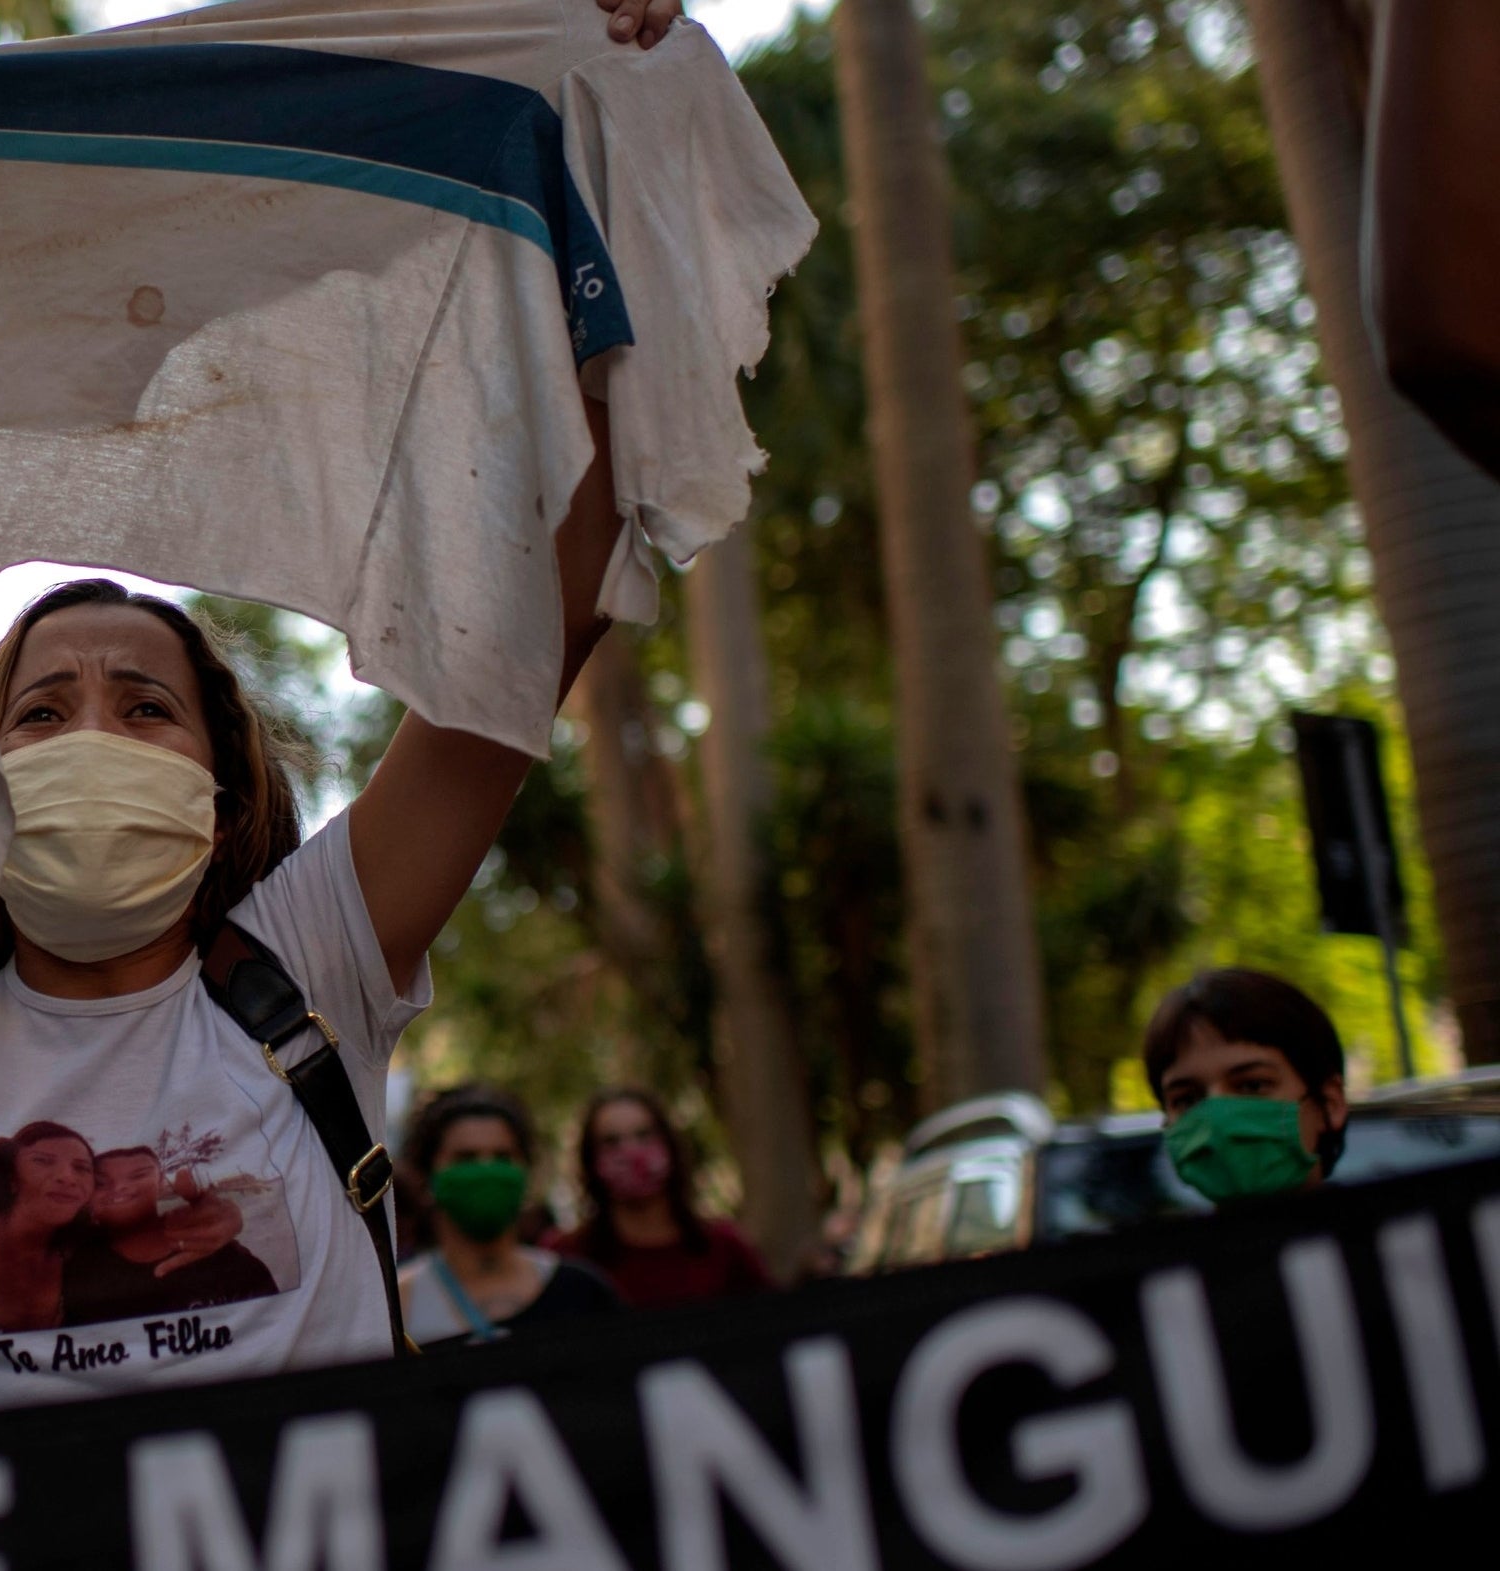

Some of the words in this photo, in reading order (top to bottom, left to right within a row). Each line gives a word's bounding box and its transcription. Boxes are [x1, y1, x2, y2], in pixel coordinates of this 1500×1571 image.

[52, 1334, 129, 1371] Amo
[143, 1315, 233, 1359] Filho
[126, 1181, 1500, 1571] MANGUI
